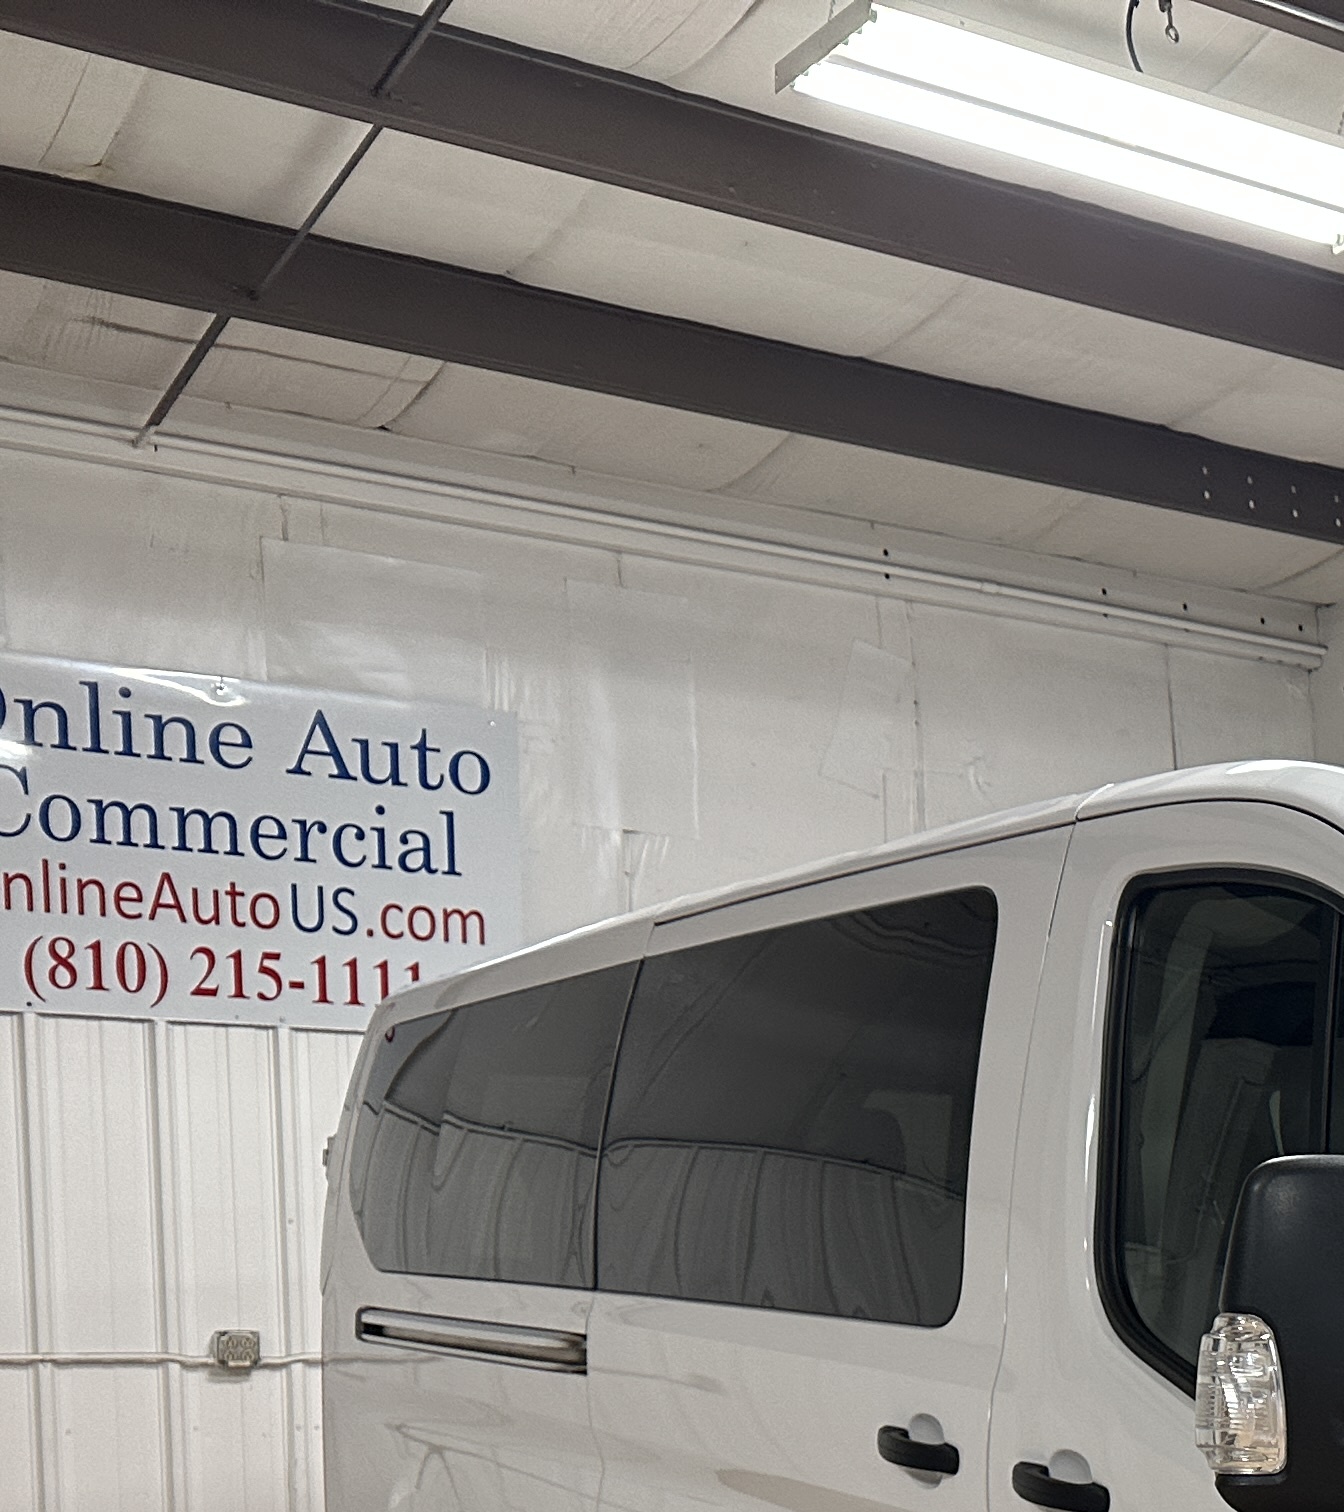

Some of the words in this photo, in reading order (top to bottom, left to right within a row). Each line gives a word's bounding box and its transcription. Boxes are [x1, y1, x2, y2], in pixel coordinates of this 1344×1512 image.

[0, 680, 254, 770] nline
[286, 708, 491, 796] Auto
[23, 935, 169, 1008] (810)
